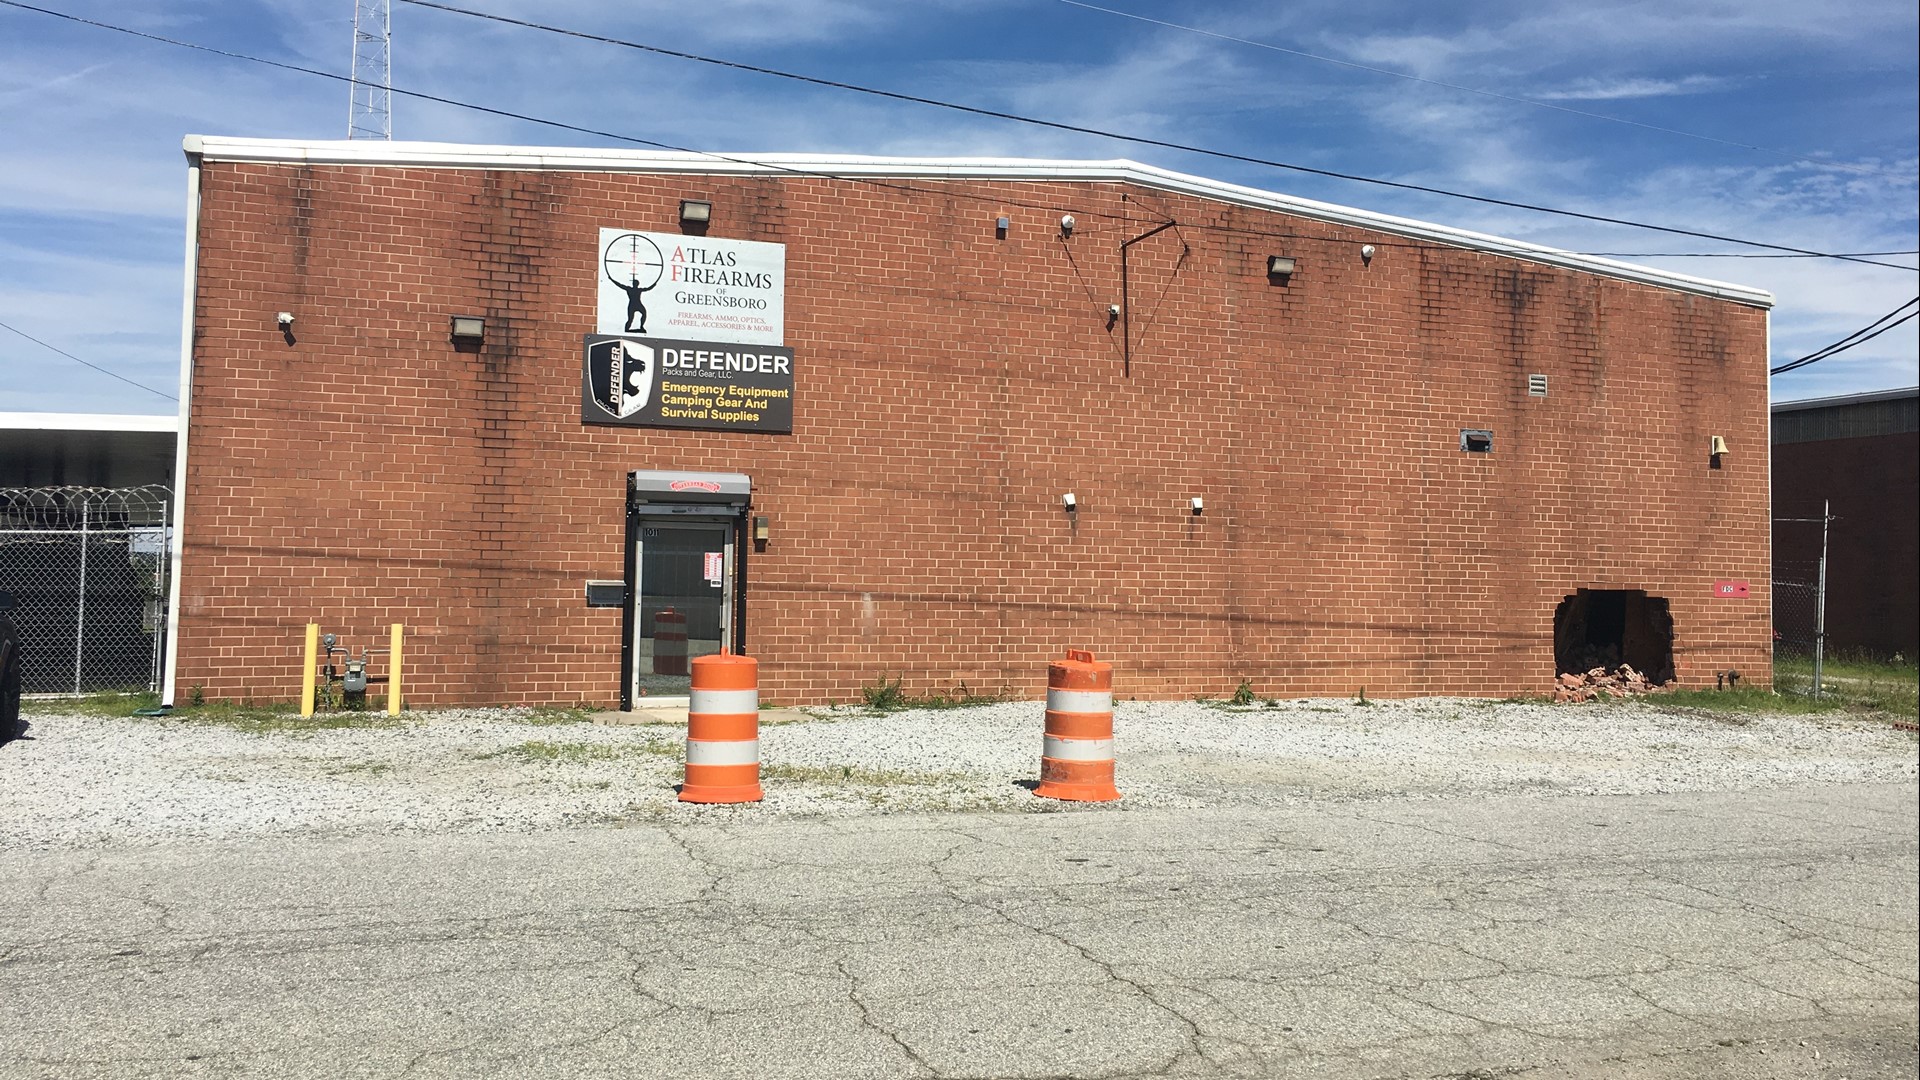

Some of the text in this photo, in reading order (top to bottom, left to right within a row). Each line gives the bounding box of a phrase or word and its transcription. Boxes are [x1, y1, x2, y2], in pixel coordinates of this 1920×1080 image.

[671, 245, 736, 267] ATLAS
[671, 265, 772, 289] FIREARMS
[675, 291, 767, 310] GREENSBORO
[668, 319, 700, 327] APPAREL,
[701, 321, 746, 331] ACCESSORIES
[678, 312, 714, 321] FIREARMS,
[715, 315, 740, 323] AMMO,
[662, 348, 790, 374] DEFENDER
[610, 347, 620, 403] DEFENDER
[662, 368, 734, 379] Packs and Gear, LLC.
[662, 381, 789, 398] Emergency Equipment
[661, 394, 768, 409] Camping Gear And
[661, 407, 760, 422] Survival Supplies
